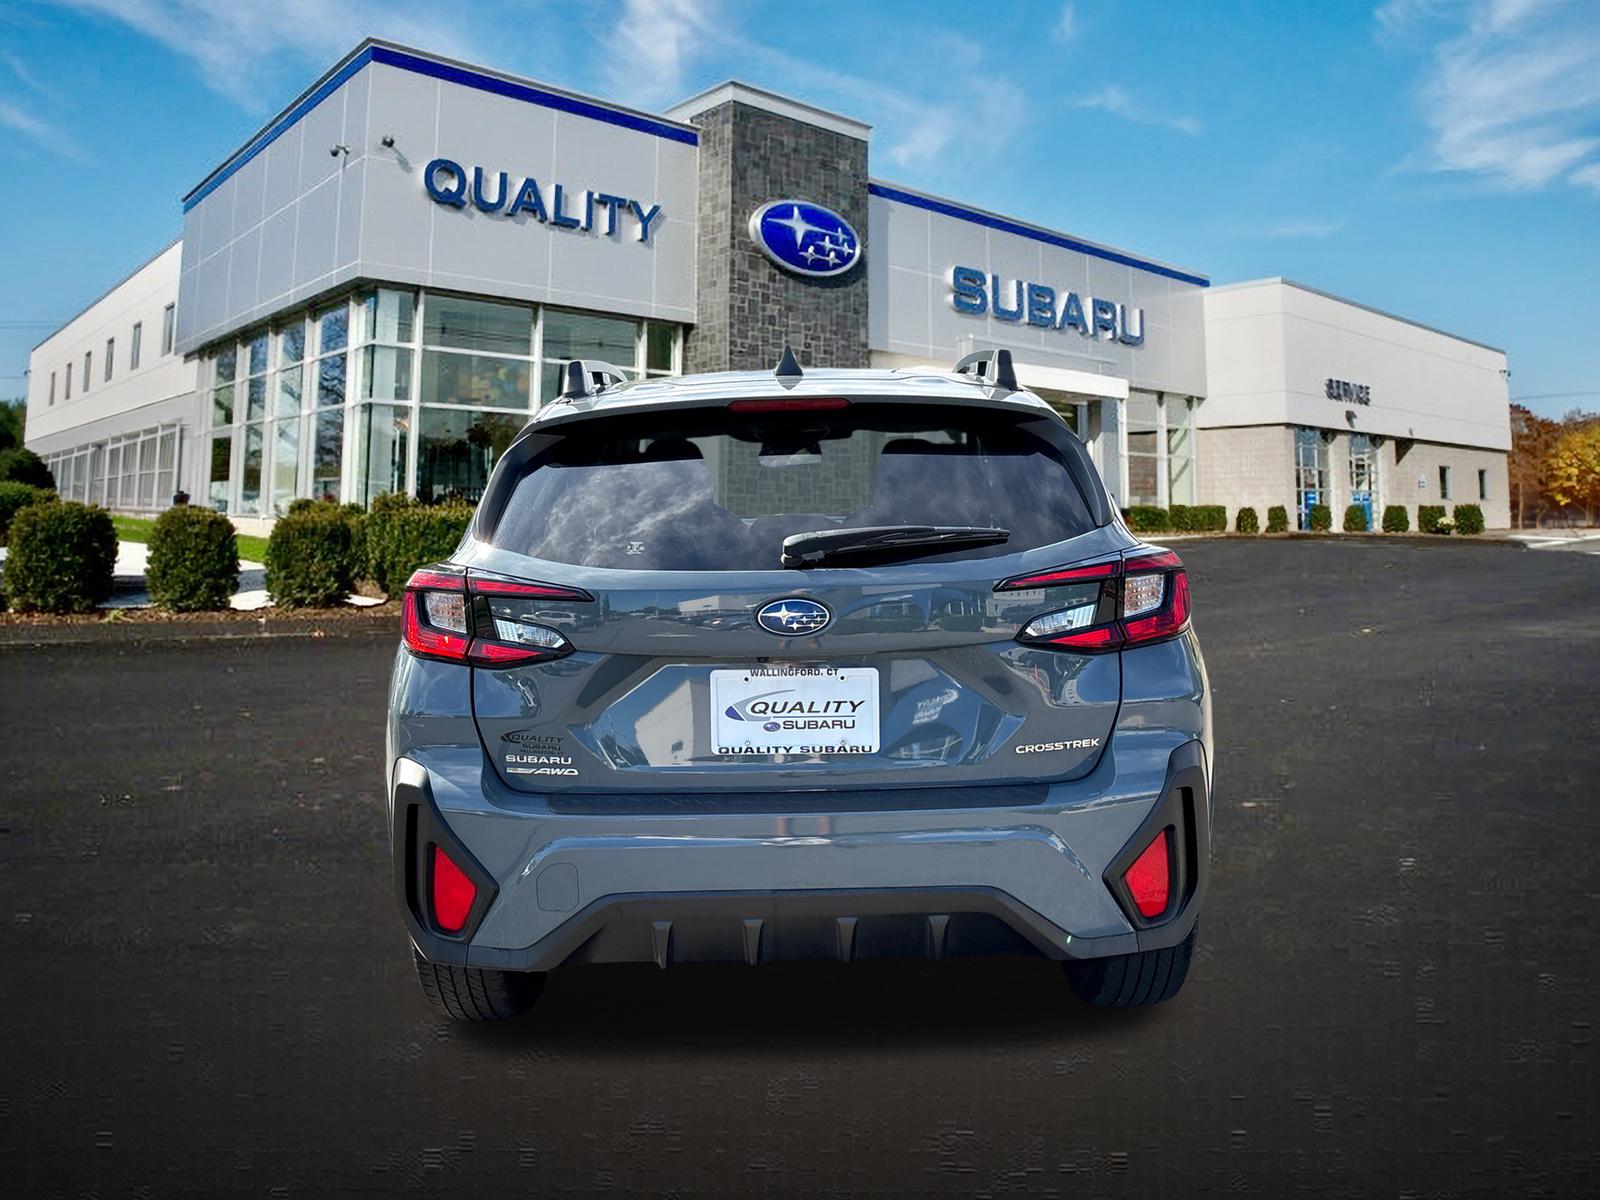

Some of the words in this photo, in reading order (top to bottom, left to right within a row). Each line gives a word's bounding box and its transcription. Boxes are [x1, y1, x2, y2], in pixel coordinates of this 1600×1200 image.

[423, 158, 662, 243] QUALITY
[949, 265, 1145, 346] SUBARU
[826, 667, 839, 676] CT
[750, 700, 866, 715] QUALITY
[782, 719, 856, 730] SUBARU
[512, 733, 564, 743] QUALITY
[718, 745, 793, 754] QUALITY
[799, 745, 873, 754] SUBARU
[1015, 738, 1100, 754] CROSSTREK
[505, 754, 572, 765] SUBARU
[532, 767, 579, 776] AWD
